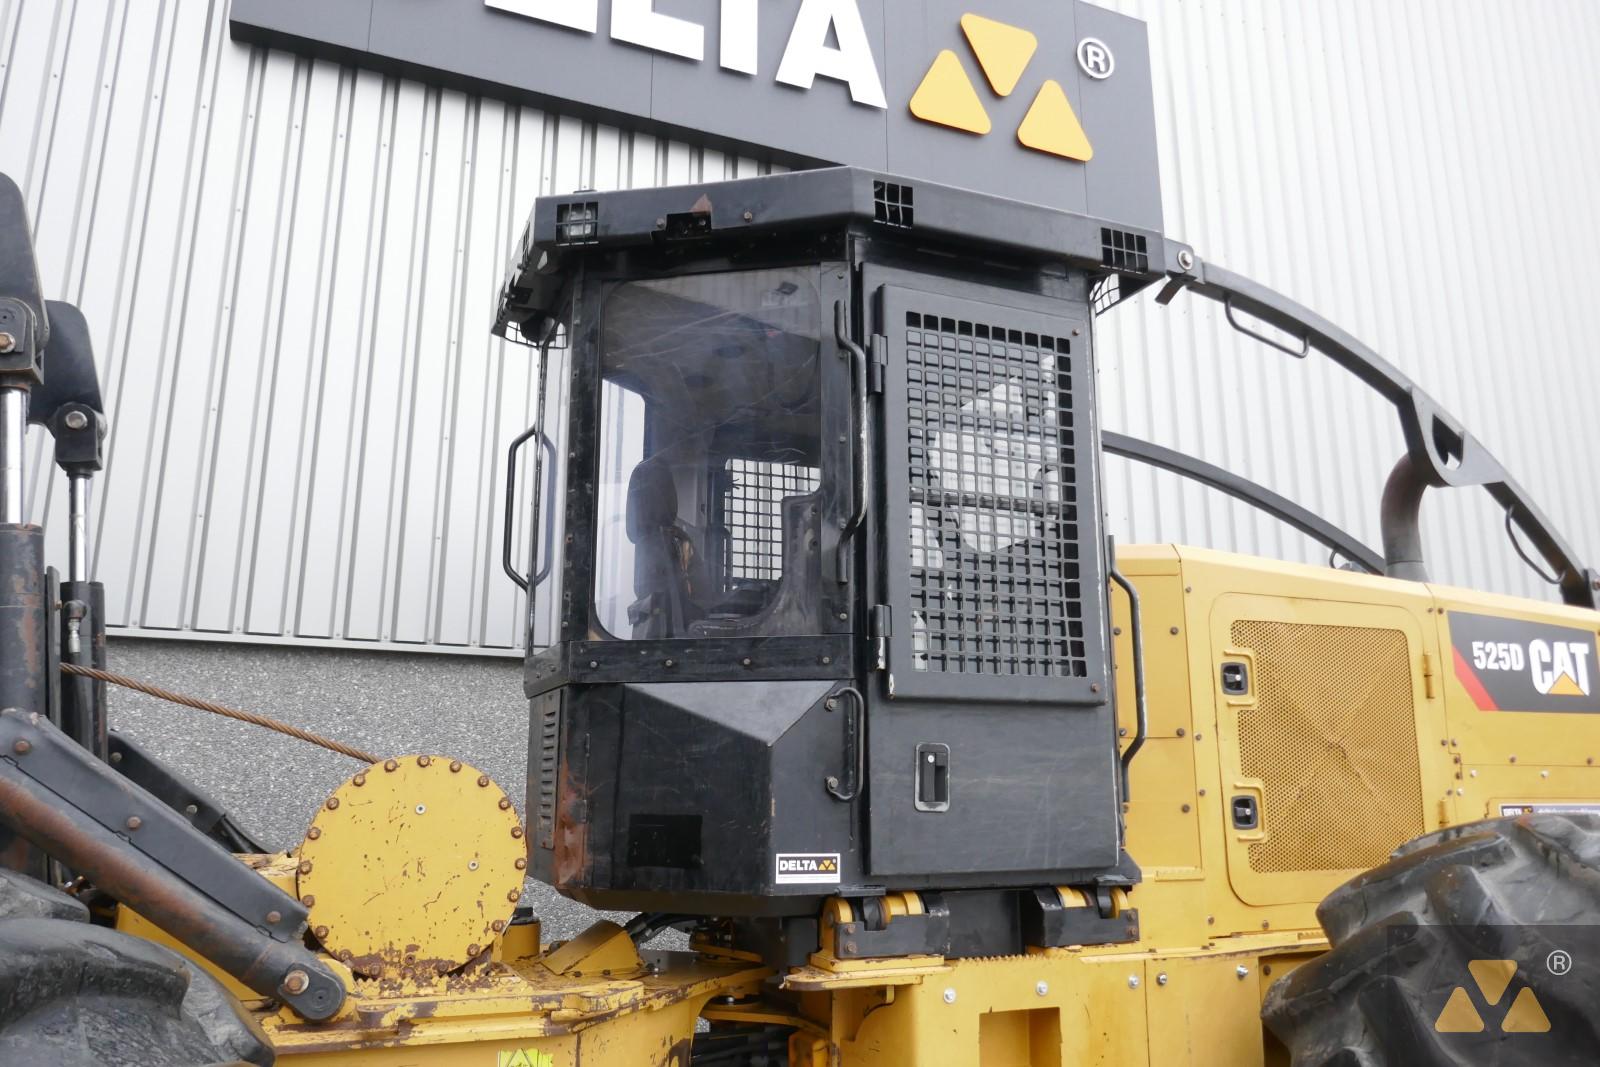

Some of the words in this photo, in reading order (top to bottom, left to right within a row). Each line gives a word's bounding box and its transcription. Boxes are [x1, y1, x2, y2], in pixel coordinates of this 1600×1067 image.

[1472, 641, 1524, 671] 525D
[1529, 639, 1589, 696] CAT
[779, 859, 818, 871] DELTA
